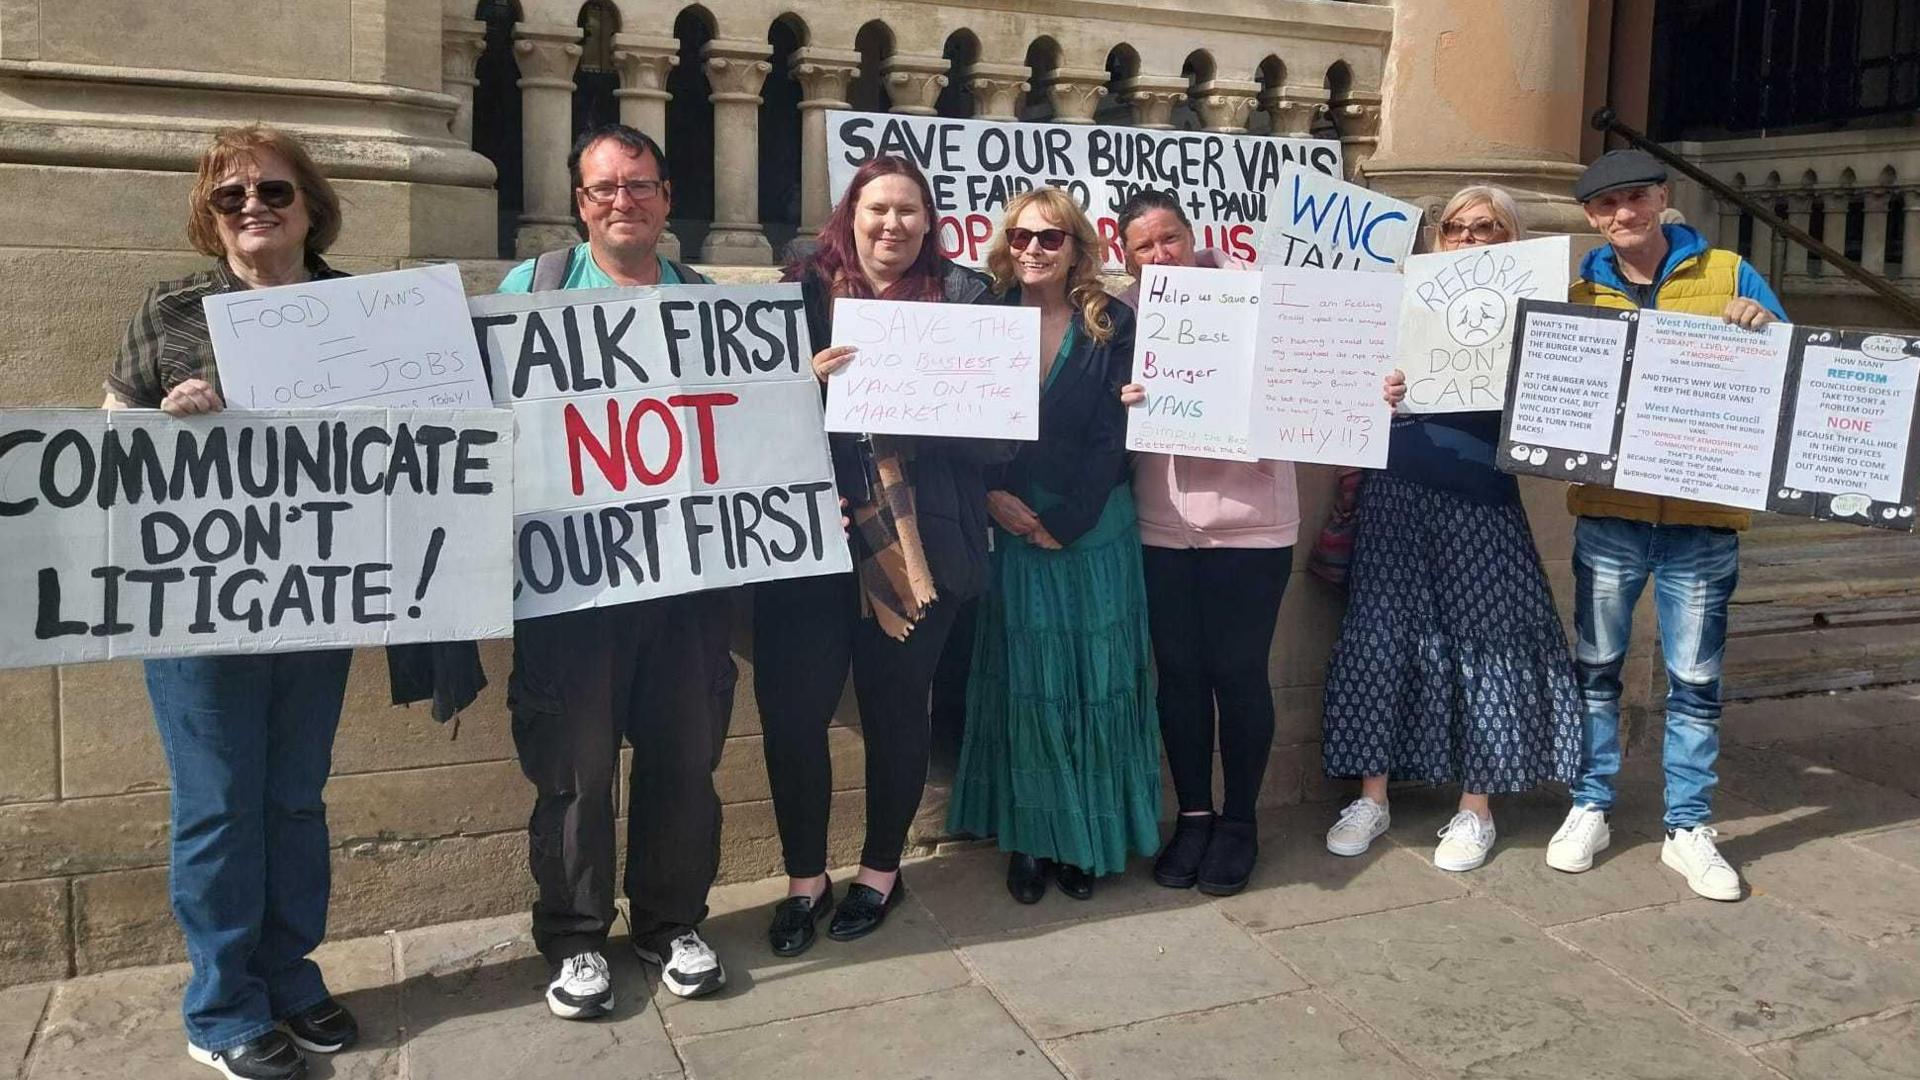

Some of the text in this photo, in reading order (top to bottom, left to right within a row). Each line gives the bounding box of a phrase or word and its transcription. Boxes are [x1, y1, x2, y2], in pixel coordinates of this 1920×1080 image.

[839, 118, 966, 172] SAVE
[978, 127, 1075, 175] OUR
[1088, 129, 1226, 190] BURGER
[1210, 189, 1267, 222] PAUL
[1293, 174, 1407, 264] WNC
[1416, 250, 1538, 312] REFORM
[1149, 275, 1190, 305] Help
[1319, 300, 1338, 308] am
[226, 295, 330, 338] FOOD
[855, 304, 1025, 344] SAVE THE
[1531, 319, 1579, 331] WHAT'S THE
[1656, 317, 1733, 333] West Northants
[1145, 312, 1230, 345] 2 Best
[1530, 330, 1617, 345] DIFFERENCE BETWEEN
[472, 299, 803, 400] TALK FIRST
[1529, 340, 1544, 348] THE
[1546, 342, 1578, 352] BURGER
[1580, 346, 1601, 355] VANS
[1736, 346, 1778, 357] FRIENDLY
[1528, 350, 1583, 363] THE COUNCIL?
[1834, 357, 1885, 369] HOW MANY
[368, 350, 465, 391] JOB'S
[1142, 351, 1218, 384] Burger
[1827, 368, 1888, 384] REFORM
[847, 377, 1013, 398] VANS ON THE
[1524, 371, 1609, 388] AT THE BURGER VANS
[1641, 373, 1771, 395] AND THAT'S WHY WE VOTED TO
[1541, 384, 1558, 392] CAN
[1560, 386, 1581, 396] HAVE
[1590, 391, 1609, 399] NICE
[1654, 385, 1754, 404] KEEP THE BURGER VANS!
[1810, 380, 1901, 397] COUNCILLORS DOES IT
[1147, 392, 1204, 418] VANS
[1521, 392, 1600, 408] FRIENDLY CHAT, BUT
[1822, 392, 1840, 400] TAKE
[1843, 394, 1854, 402] TO
[1856, 396, 1879, 405] SORT
[1520, 403, 1593, 419] WNC JUST IGNORE
[1645, 402, 1760, 424] West Northants Council
[1819, 402, 1885, 416] PROBLEM OUT?
[1516, 424, 1544, 434] BACKS!
[1518, 413, 1535, 422] YOU
[1545, 417, 1567, 426] TURN
[1569, 419, 1592, 430] THEIR
[1698, 421, 1725, 429] REMOVE
[1739, 426, 1765, 434] BURGER
[1827, 416, 1873, 432] NONE
[564, 392, 739, 496] NOT
[1651, 431, 1680, 440] IMPROVE
[1697, 437, 1741, 448] ATMOSPHERE
[1655, 440, 1698, 451] COMMUNITY
[1797, 429, 1899, 450] BECAUSE THEY ALL HIDE
[1667, 450, 1693, 460] THAT'S
[1809, 442, 1882, 457] IN THEIR OFFICES
[0, 420, 499, 516] COMMUNICATE
[1627, 453, 1762, 479] BECAUSE BEFORE THEY DEMANDED THE
[1802, 451, 1887, 469] REFUSING TO COME
[1664, 467, 1684, 475] VANS
[1795, 462, 1890, 481] OUT AND WON'T TALK
[1664, 475, 1761, 495] WAS GETTING ALONG JUST
[1814, 475, 1868, 489] TO ANYONE!
[141, 501, 353, 565] DON'T
[513, 482, 833, 601] OURT FIRST
